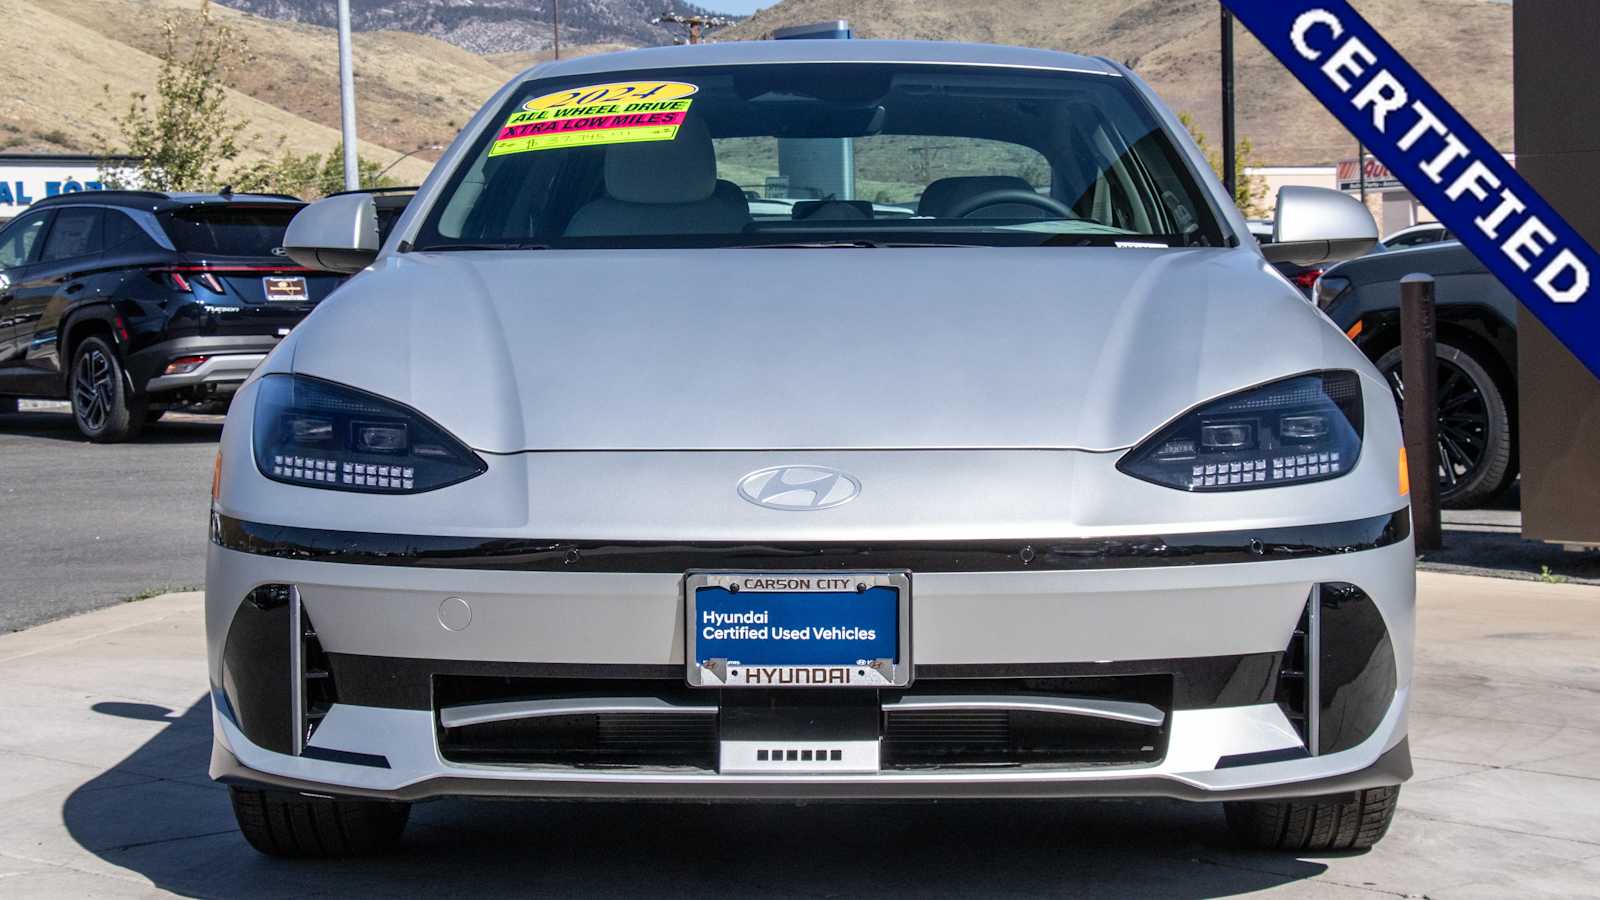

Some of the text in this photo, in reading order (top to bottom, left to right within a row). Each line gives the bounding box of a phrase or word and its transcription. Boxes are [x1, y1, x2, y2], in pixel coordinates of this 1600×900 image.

[544, 84, 669, 108] 2024
[511, 101, 688, 124] ALL WHEEL DRIVE
[504, 112, 676, 137] XTRA LOW MILES
[744, 578, 851, 590] CARSON CITY
[703, 610, 769, 626] Hyundai
[703, 626, 877, 641] Certified Used Vehicles
[745, 667, 850, 684] HYUNDAI
